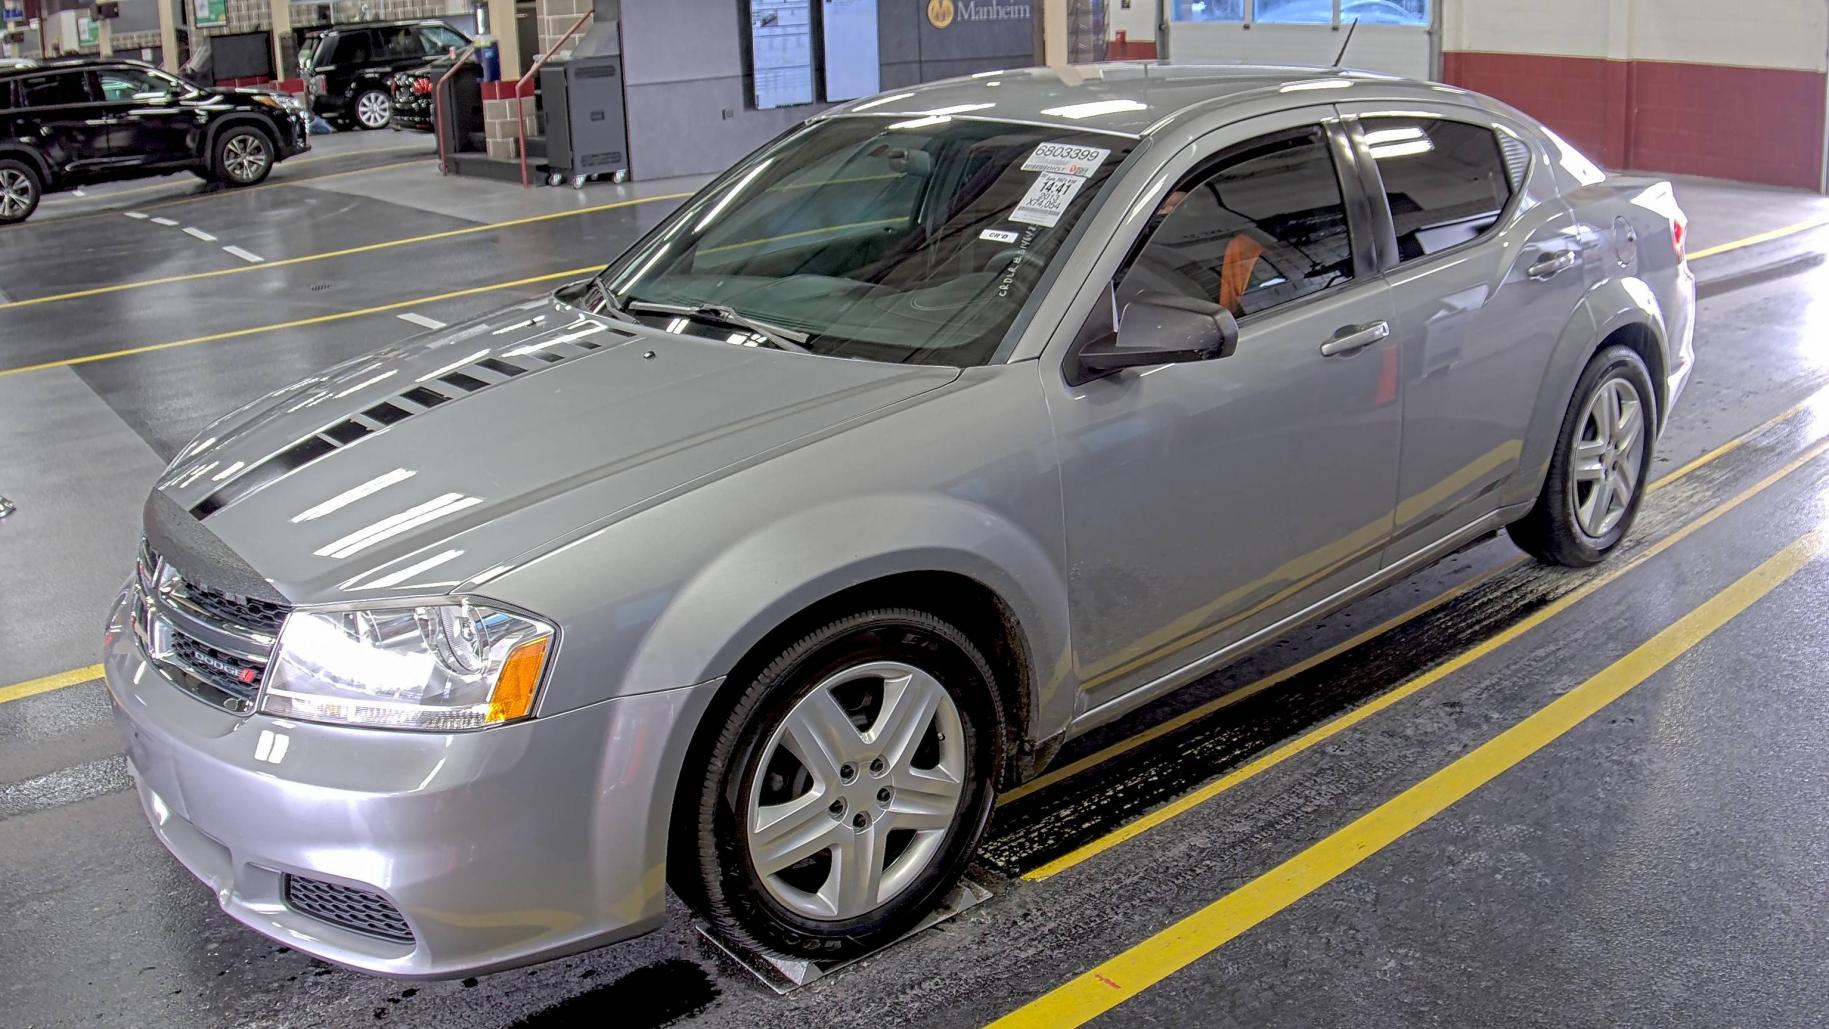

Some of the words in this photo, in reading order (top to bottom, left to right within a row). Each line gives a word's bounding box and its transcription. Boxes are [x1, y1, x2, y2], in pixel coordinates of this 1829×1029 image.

[957, 0, 1031, 21] Manheim
[1035, 145, 1099, 162] 6803399
[1040, 180, 1072, 195] 14:41
[194, 651, 242, 676] DODGE
